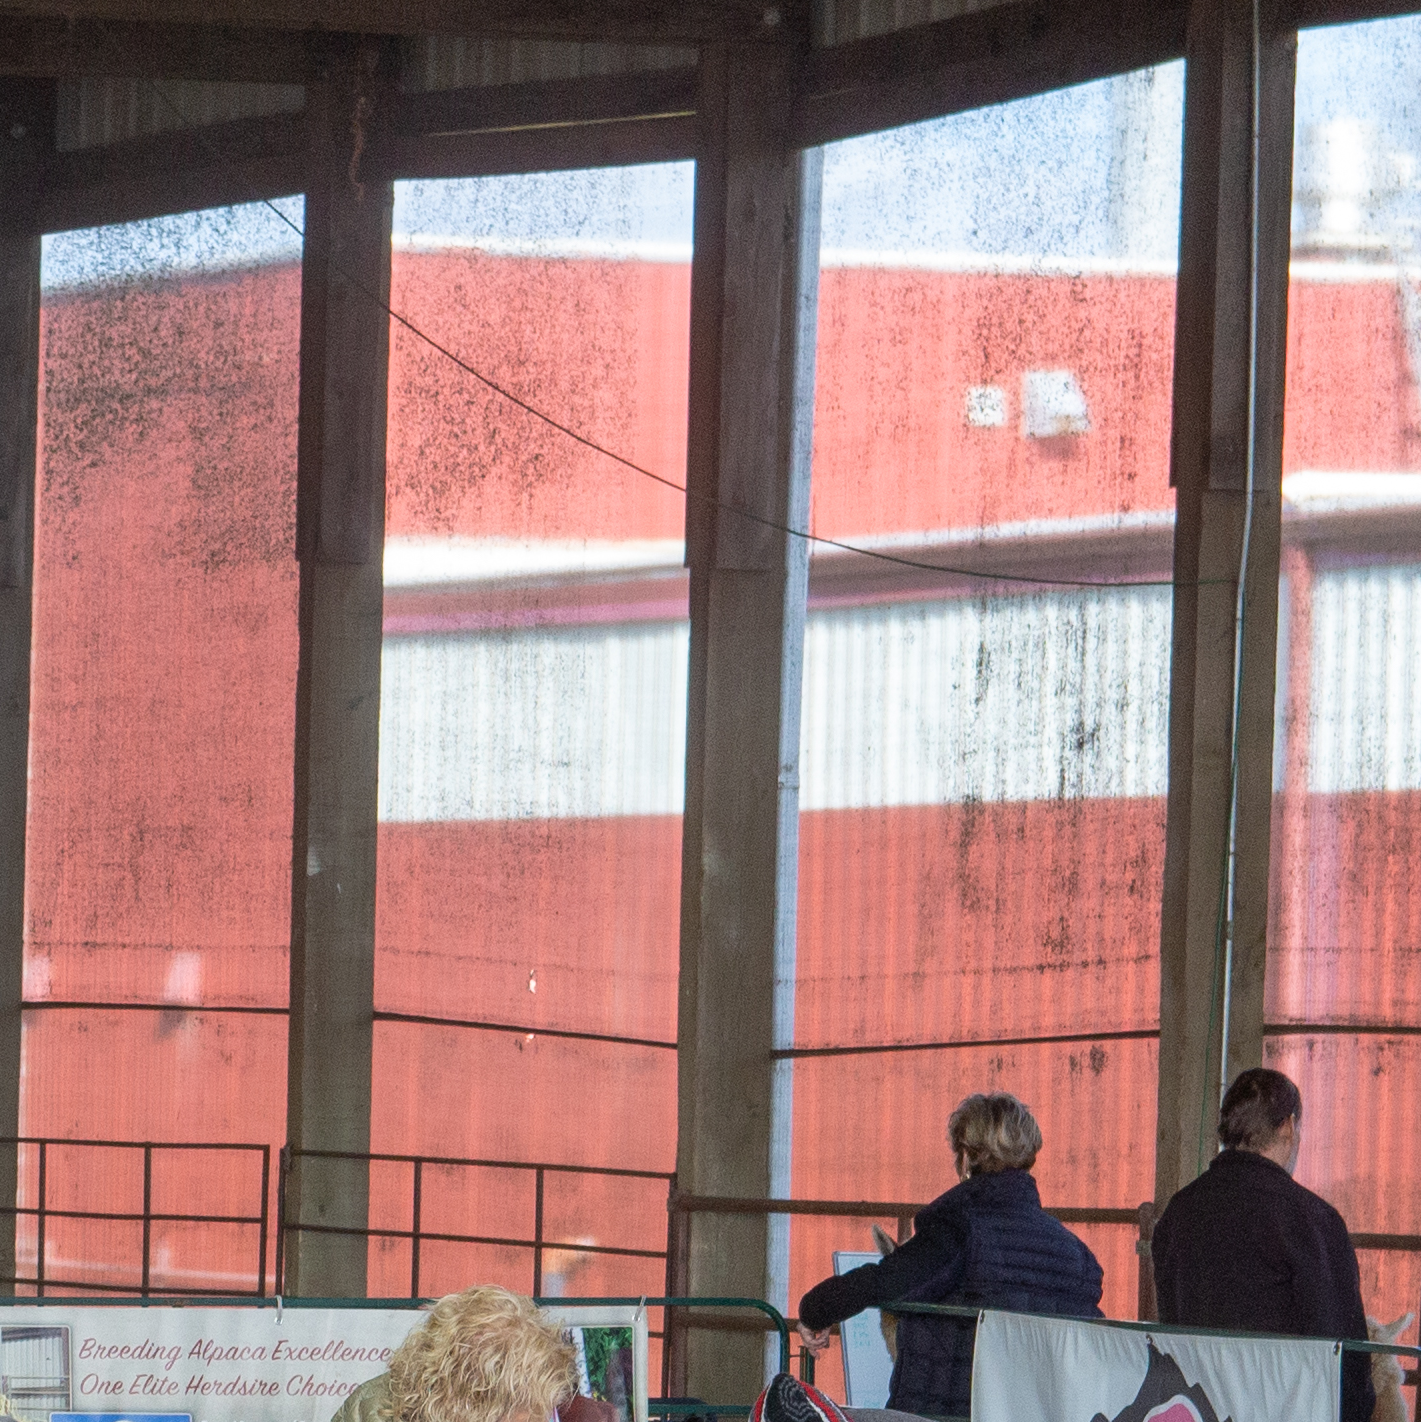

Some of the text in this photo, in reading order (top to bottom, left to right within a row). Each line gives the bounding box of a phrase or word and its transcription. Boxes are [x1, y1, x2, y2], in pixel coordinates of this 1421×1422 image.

[78, 1338, 393, 1371] Breeding Alpaca Excellence
[80, 1373, 124, 1396] One
[129, 1374, 179, 1396] Elite
[185, 1374, 280, 1397] Herdsire
